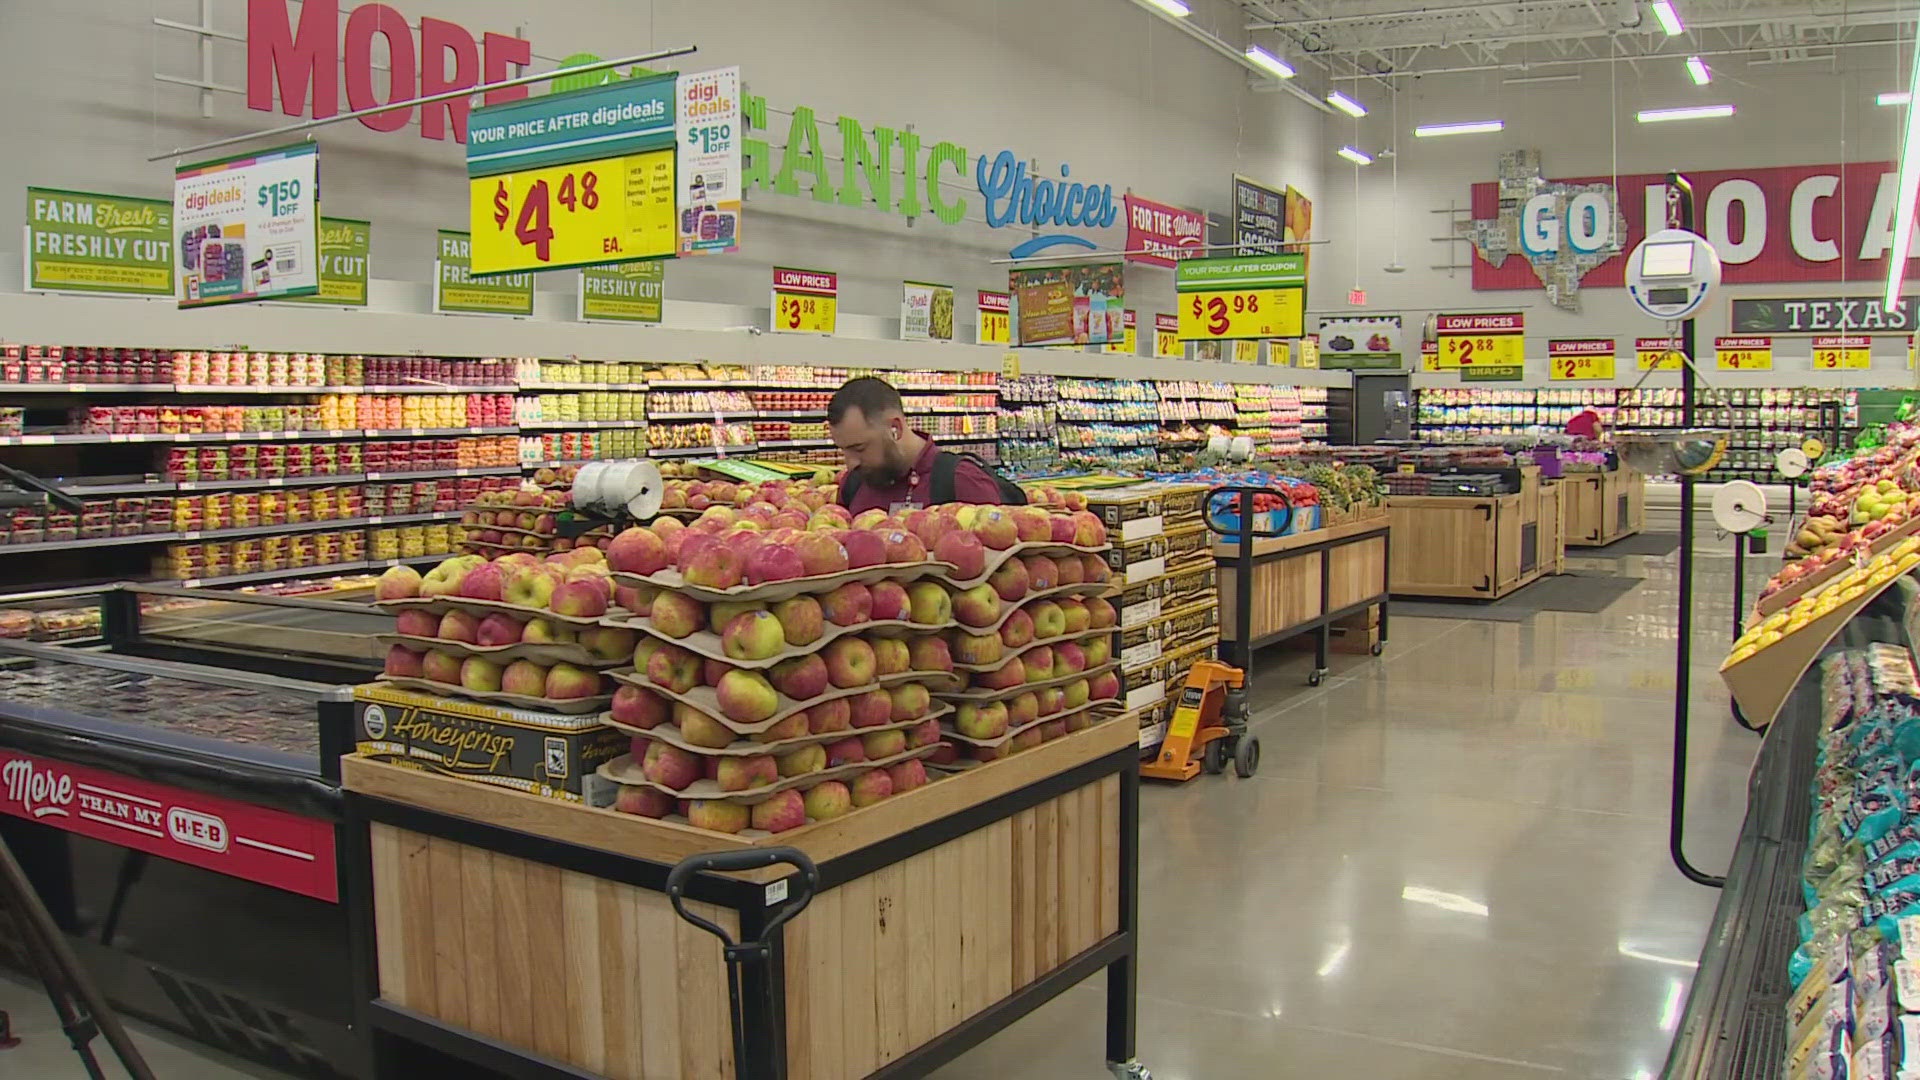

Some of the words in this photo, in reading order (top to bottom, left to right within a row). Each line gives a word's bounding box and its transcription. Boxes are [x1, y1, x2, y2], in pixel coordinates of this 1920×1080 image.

[247, 0, 531, 143] MORE
[688, 80, 718, 101] digi
[688, 96, 730, 117] deals
[471, 126, 505, 145] YOUR
[508, 119, 544, 139] PRICE
[548, 112, 589, 132] AFTER
[592, 99, 665, 126] digideals
[710, 141, 730, 153] OFF
[185, 186, 242, 210] digideals
[977, 150, 1117, 228] Choices
[35, 199, 93, 225] FARM
[96, 203, 156, 228] Fresh
[279, 203, 299, 216] OFF
[1132, 205, 1152, 232] FOR
[1153, 210, 1172, 237] THE
[1173, 214, 1201, 237] Whole
[1522, 192, 1610, 255] GO
[320, 225, 353, 244] resh
[35, 231, 127, 259] FRESHLY
[133, 240, 170, 262] CUT
[443, 239, 468, 258] FAR
[334, 255, 364, 277] CUT
[1184, 265, 1207, 276] YOUR
[1208, 265, 1232, 275] PRICE
[1233, 263, 1260, 273] AFTER
[1260, 262, 1297, 272] COUPON
[586, 277, 636, 297] FRESHLY
[640, 281, 661, 299] CUT
[781, 272, 801, 286] LOW
[802, 275, 830, 288] PRICES
[983, 294, 997, 306] LOW
[1446, 318, 1473, 328] LOW
[1474, 317, 1514, 328] PRICES
[1784, 301, 1907, 329] TEXAS
[1556, 343, 1577, 351] LOW
[1577, 342, 1607, 351] PRICES
[1838, 337, 1865, 345] PRICES
[393, 708, 514, 772] Honeycrisp
[3, 760, 74, 812] More
[79, 792, 129, 818] THAN
[134, 807, 162, 827] MY
